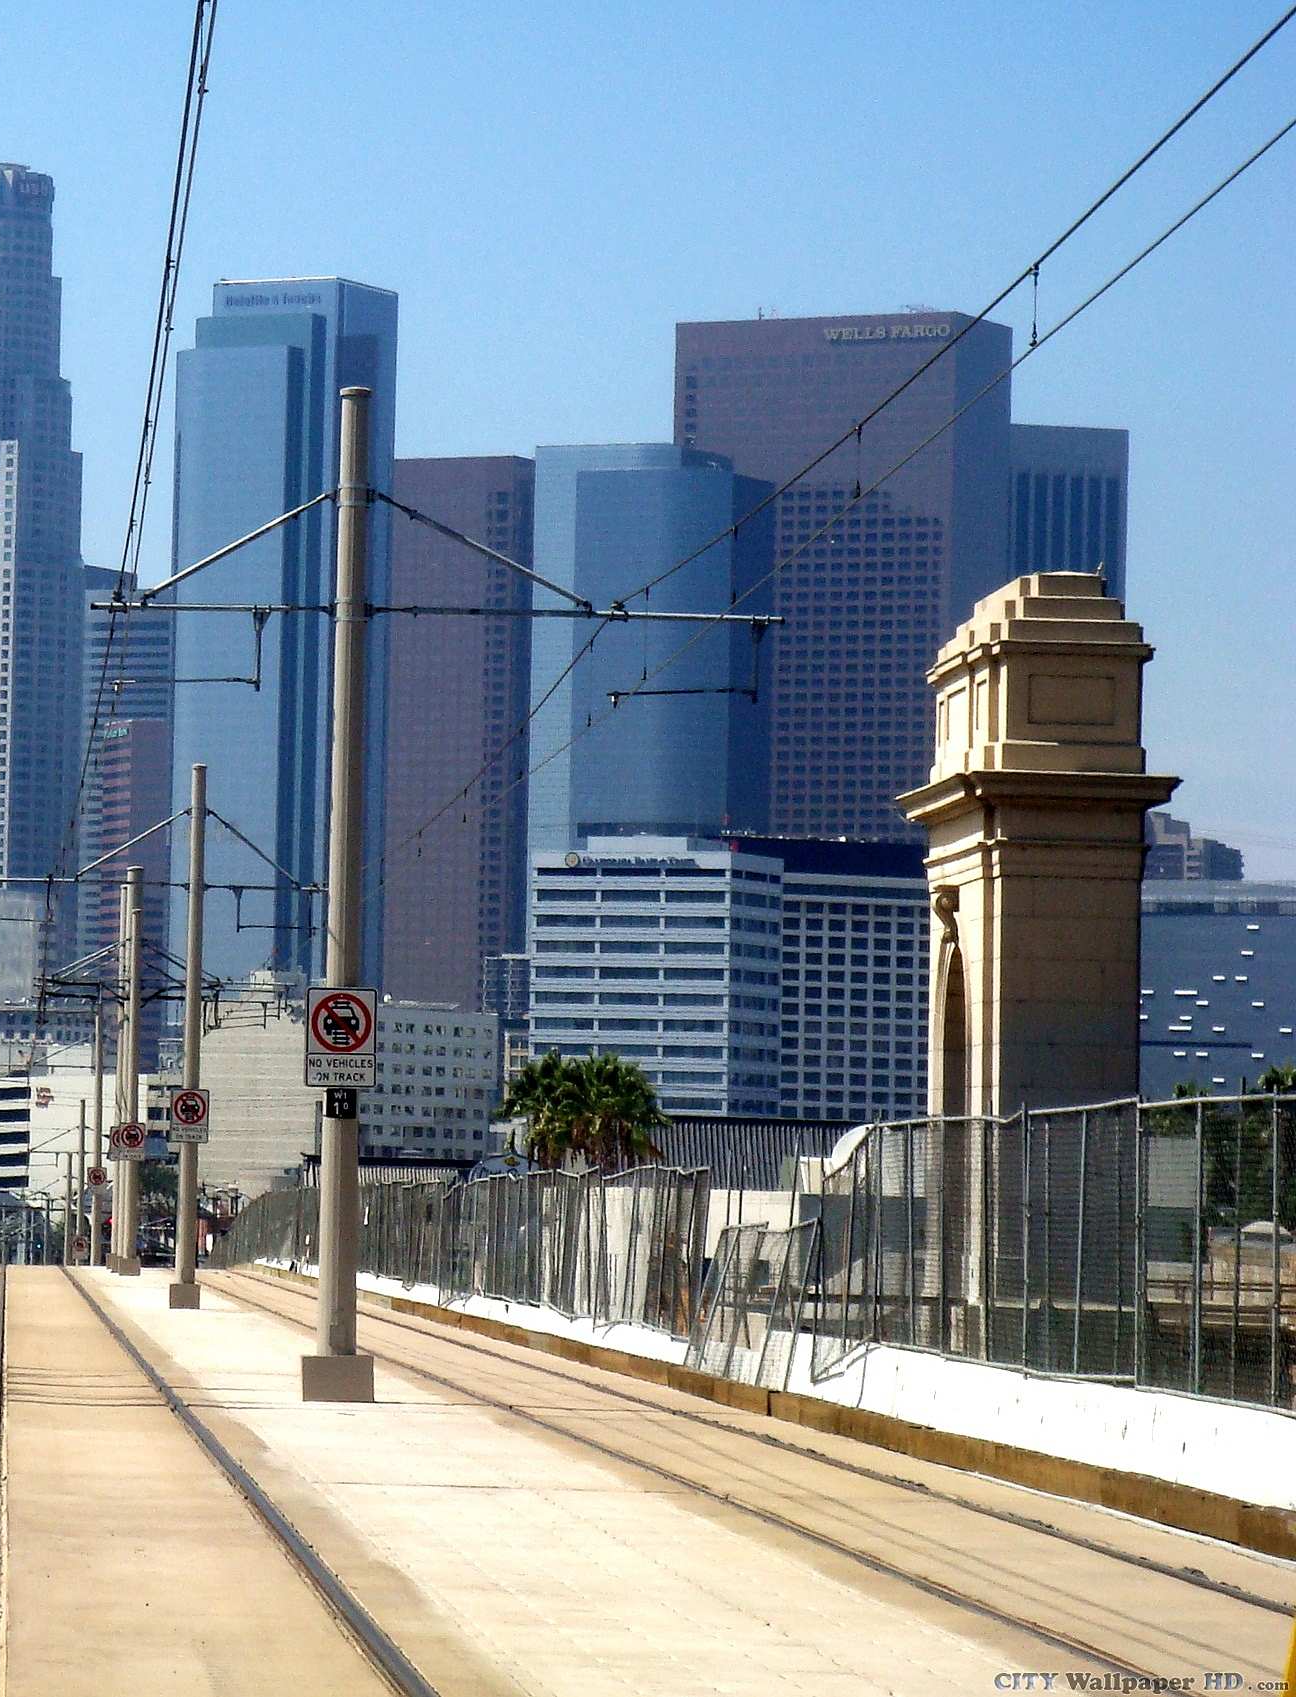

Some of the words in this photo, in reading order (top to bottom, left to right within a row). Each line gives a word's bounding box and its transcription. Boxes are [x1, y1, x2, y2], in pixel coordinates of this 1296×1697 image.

[824, 325, 886, 341] WELLS
[891, 324, 950, 338] FARGO
[309, 1059, 322, 1068] NO
[327, 1059, 373, 1068] VEHICLES
[335, 1072, 365, 1081] TRACK
